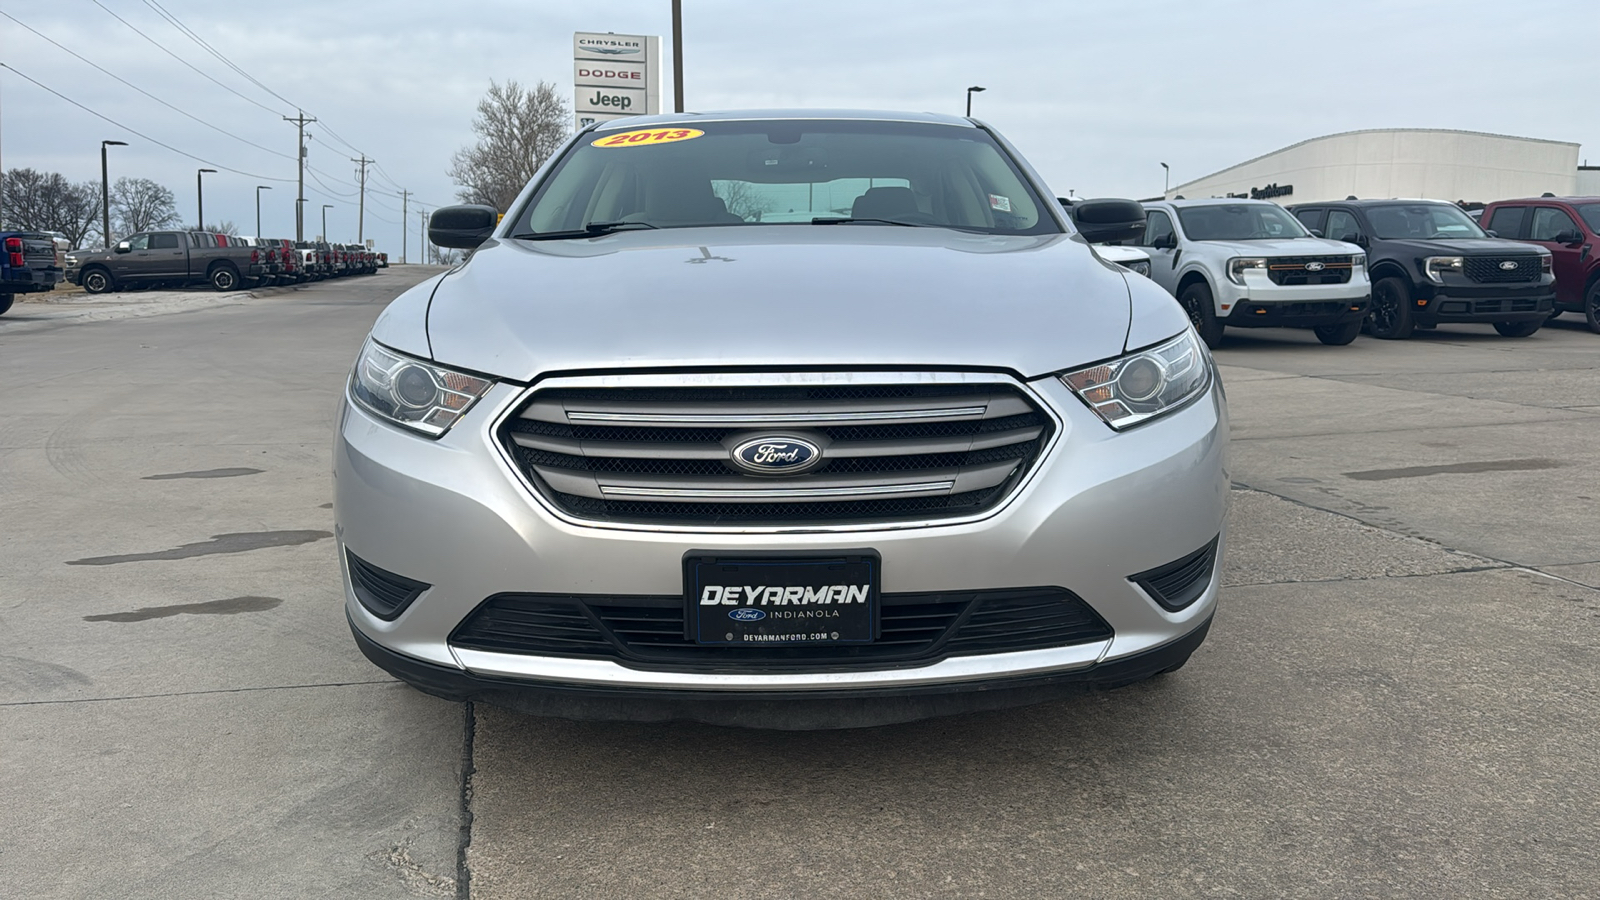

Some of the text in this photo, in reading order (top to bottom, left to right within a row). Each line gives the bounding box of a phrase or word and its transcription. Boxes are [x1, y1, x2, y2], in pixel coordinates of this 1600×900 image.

[579, 39, 639, 47] CHRYSLER
[579, 69, 641, 80] DODGE
[589, 91, 632, 110] Jeep
[604, 130, 691, 145] 2013
[1250, 183, 1293, 199] Southtown
[754, 444, 798, 462] Ford
[700, 584, 869, 606] DEYARMAN
[736, 609, 840, 619] Ford INDIANOLA
[743, 633, 828, 641] DEYARMANFORD.COM
